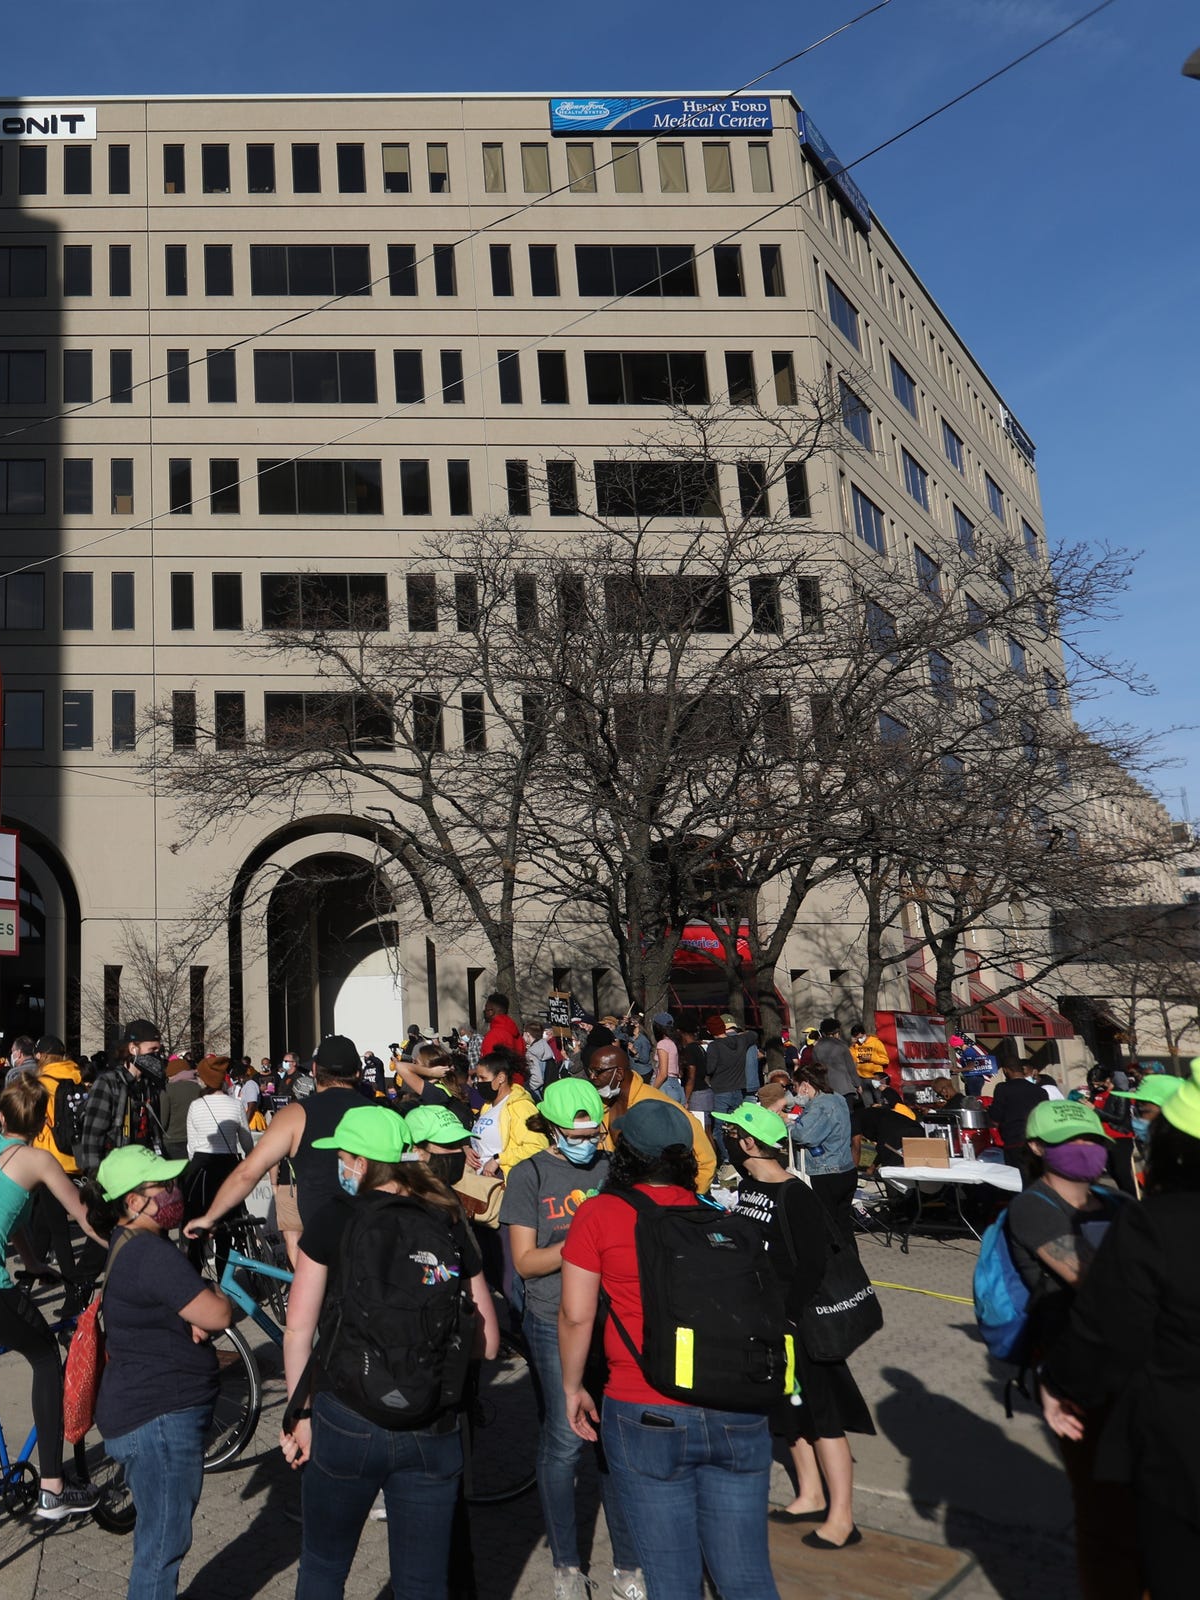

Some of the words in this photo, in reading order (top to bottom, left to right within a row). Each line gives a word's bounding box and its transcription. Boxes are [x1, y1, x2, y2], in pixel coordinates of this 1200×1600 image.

[683, 101, 726, 113] HENRY
[731, 100, 767, 112] FORD
[653, 113, 714, 128] Medical
[718, 114, 769, 128] Center
